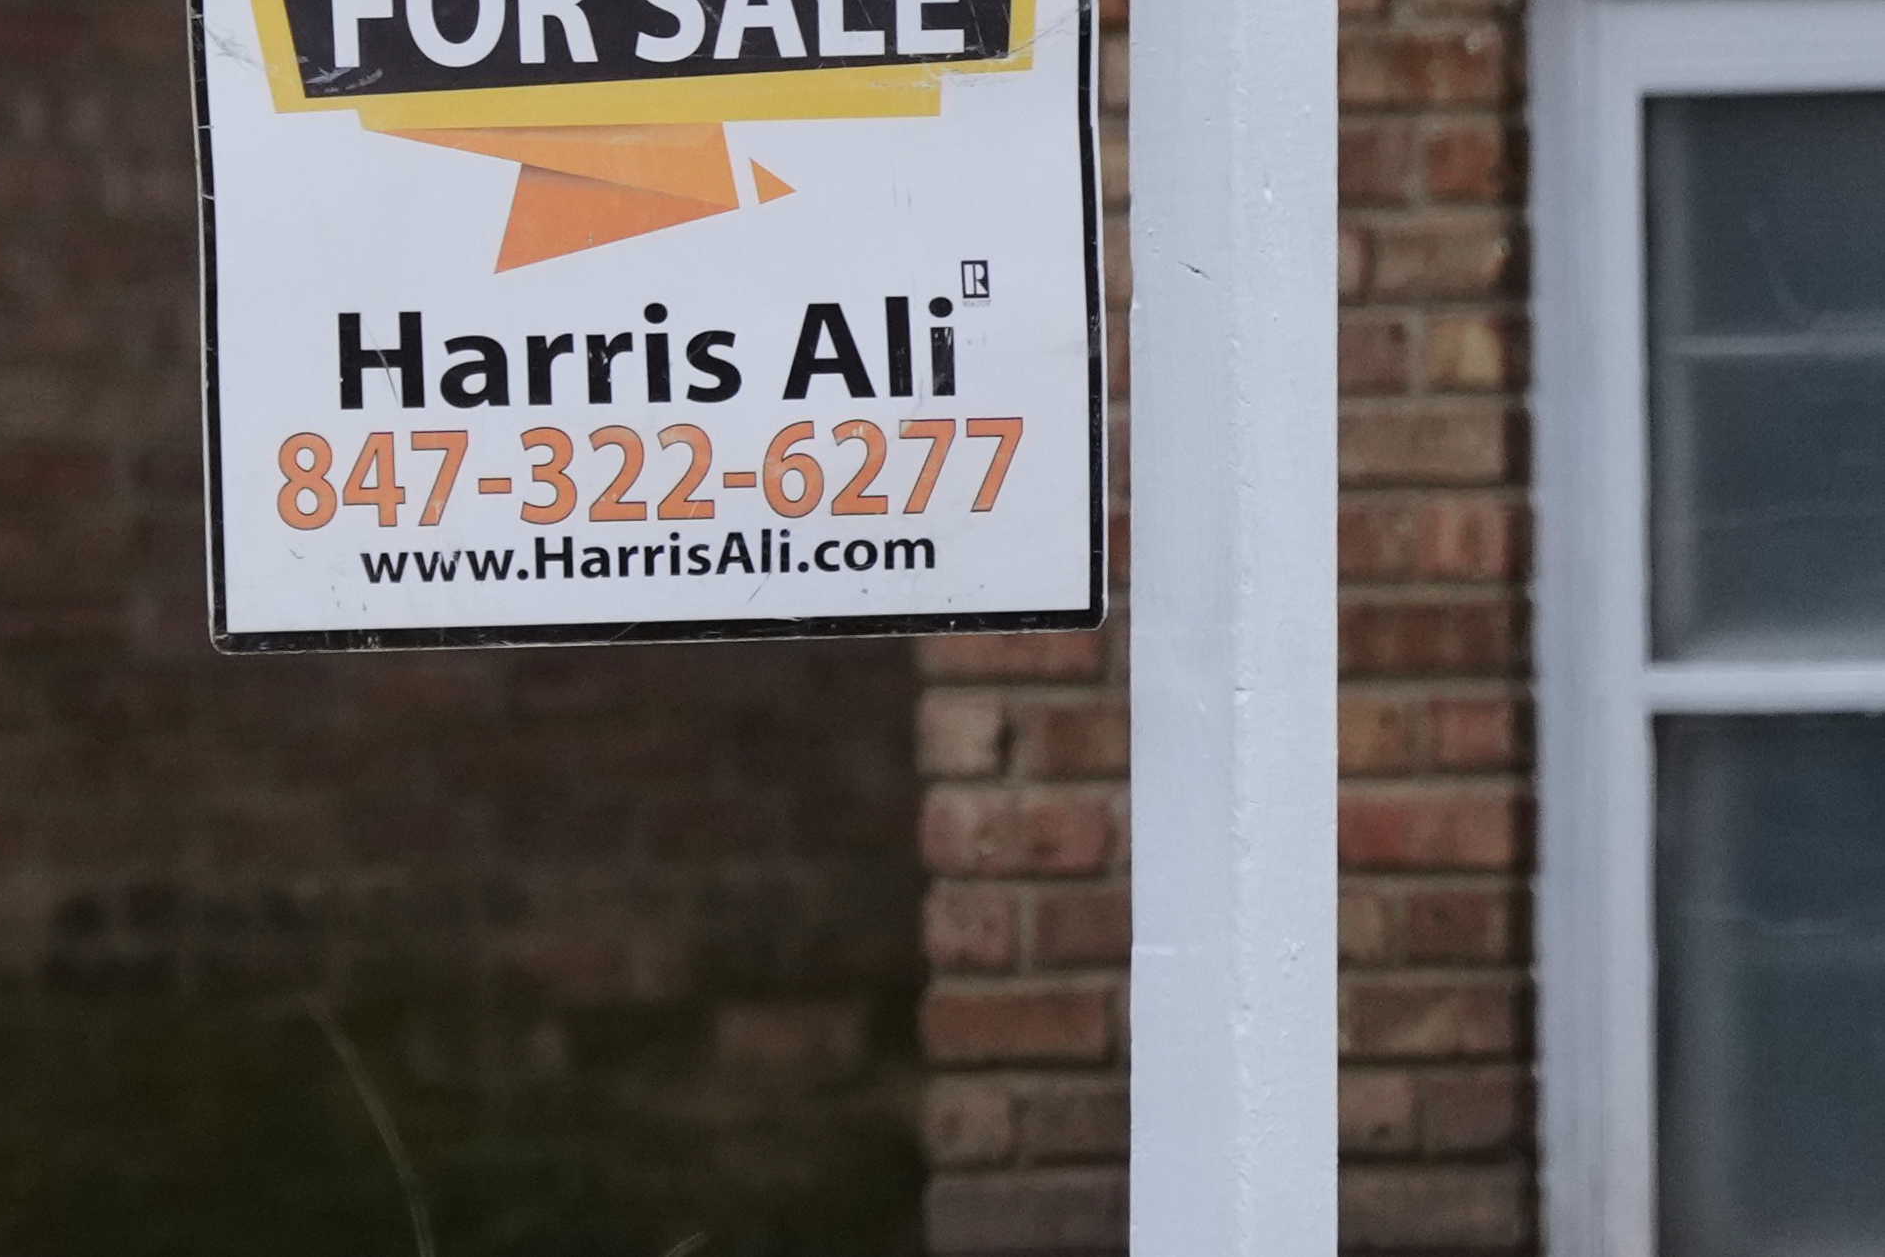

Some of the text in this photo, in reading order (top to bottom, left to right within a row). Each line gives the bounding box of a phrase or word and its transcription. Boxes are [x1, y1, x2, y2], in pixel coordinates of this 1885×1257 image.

[337, 295, 958, 411] Harris Ali
[275, 416, 1024, 531] 847-322-6277
[360, 528, 937, 585] www.HarrisAli.com
